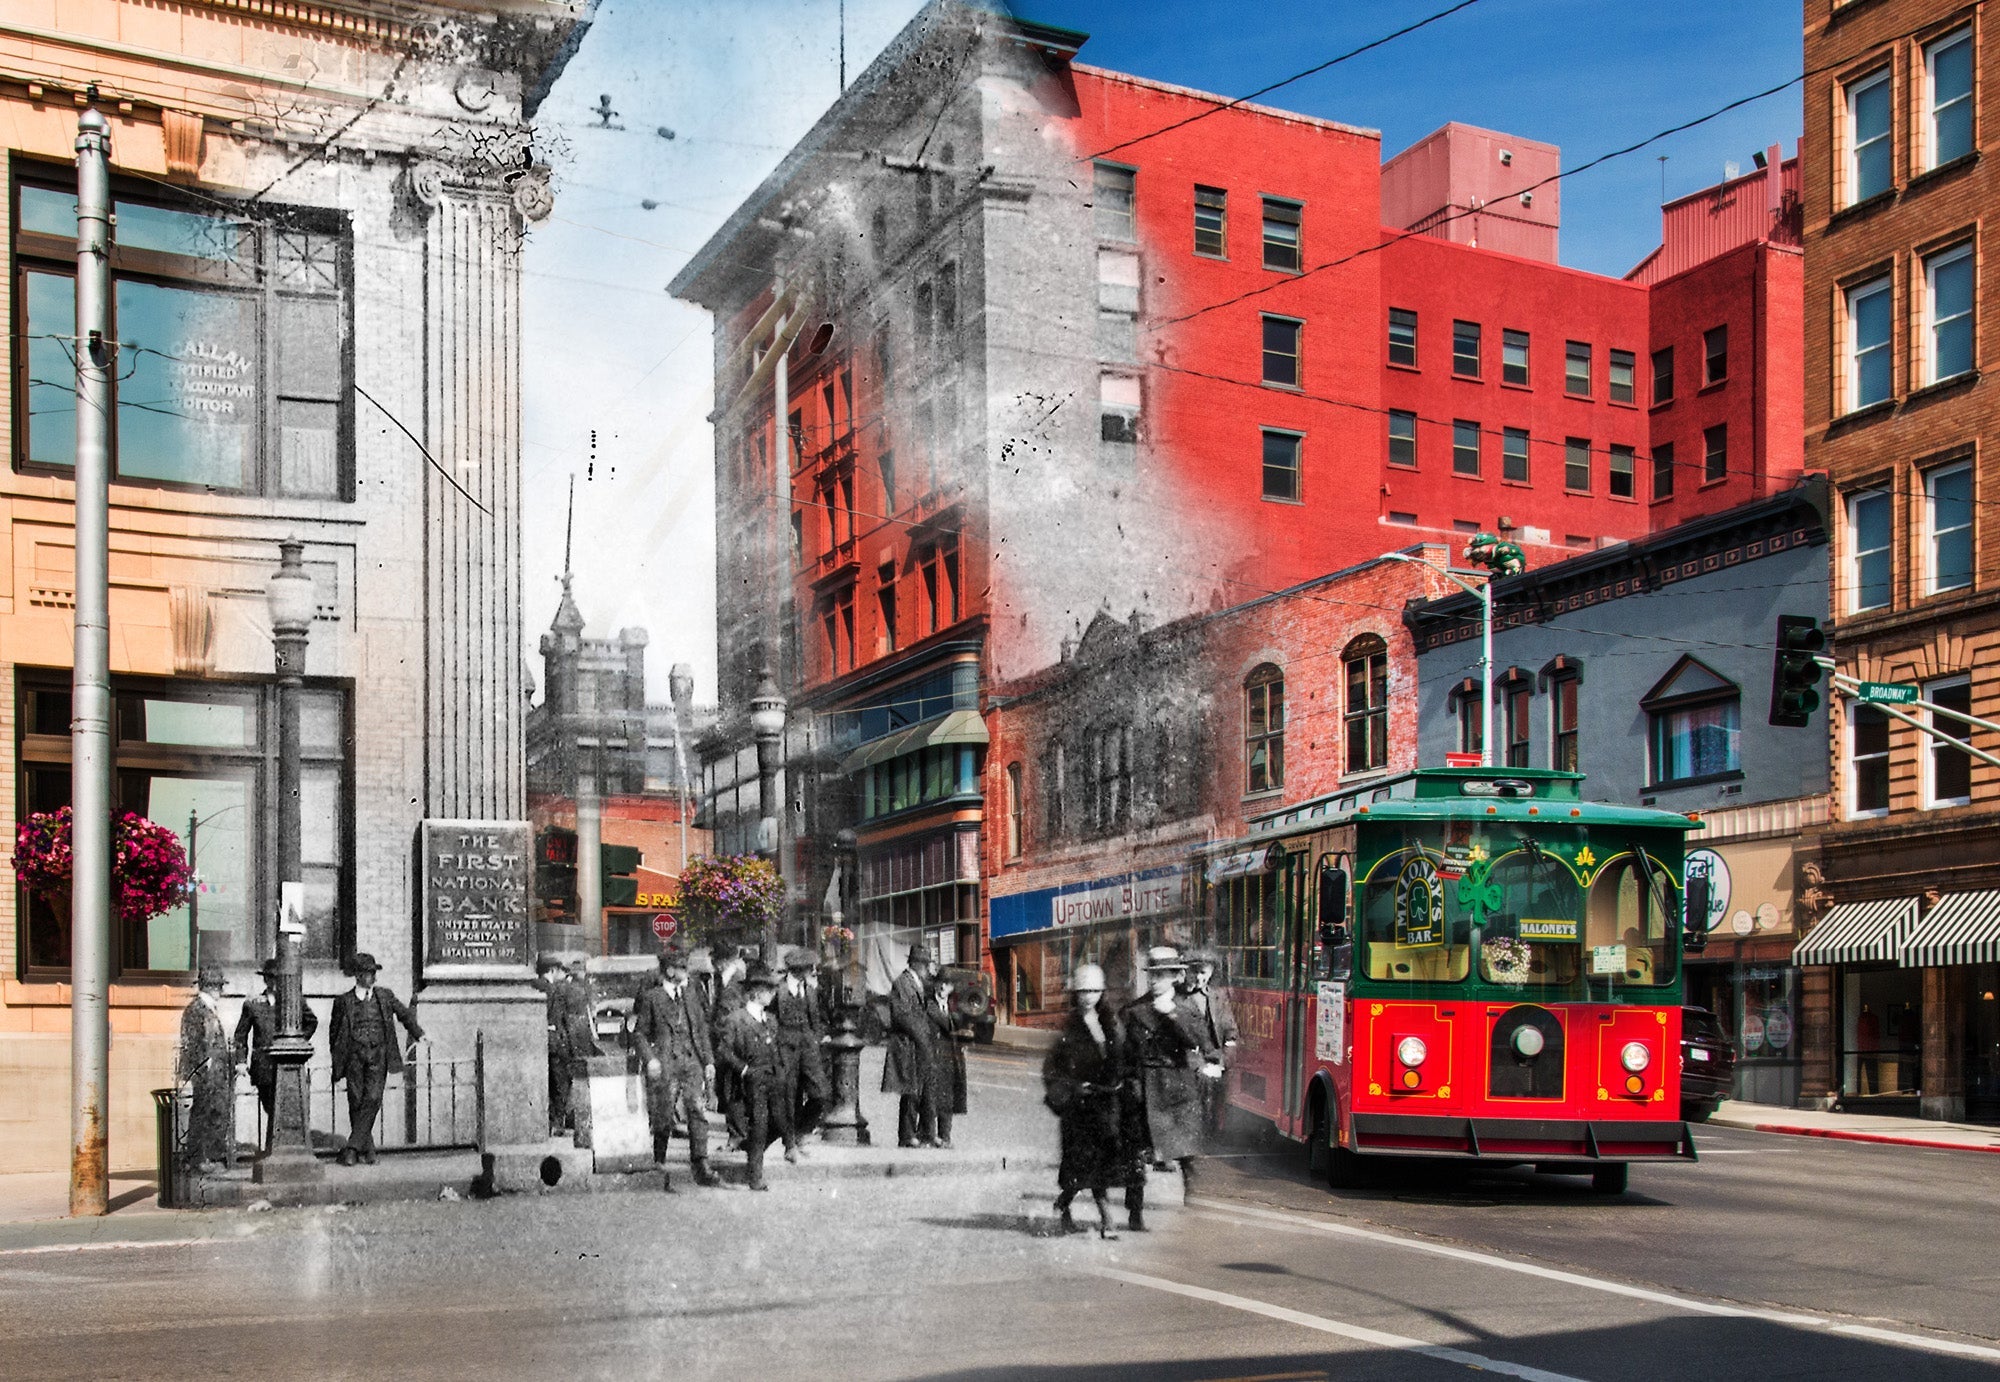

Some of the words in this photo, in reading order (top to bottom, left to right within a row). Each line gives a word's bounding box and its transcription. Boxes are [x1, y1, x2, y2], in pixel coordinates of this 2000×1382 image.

[1870, 686, 1906, 700] BROADWAY
[459, 835, 500, 849] THE
[438, 853, 519, 871] FIRST
[432, 876, 525, 891] NATIONAL
[1398, 861, 1442, 927] MALONEY'S
[1056, 897, 1114, 924] UPTOWN
[1122, 887, 1170, 915] BUTTE
[437, 920, 479, 930] UNITED
[481, 921, 520, 930] STATES
[654, 921, 675, 931] STOP
[1520, 923, 1577, 935] MALONEY'S
[1407, 930, 1432, 944] BAR
